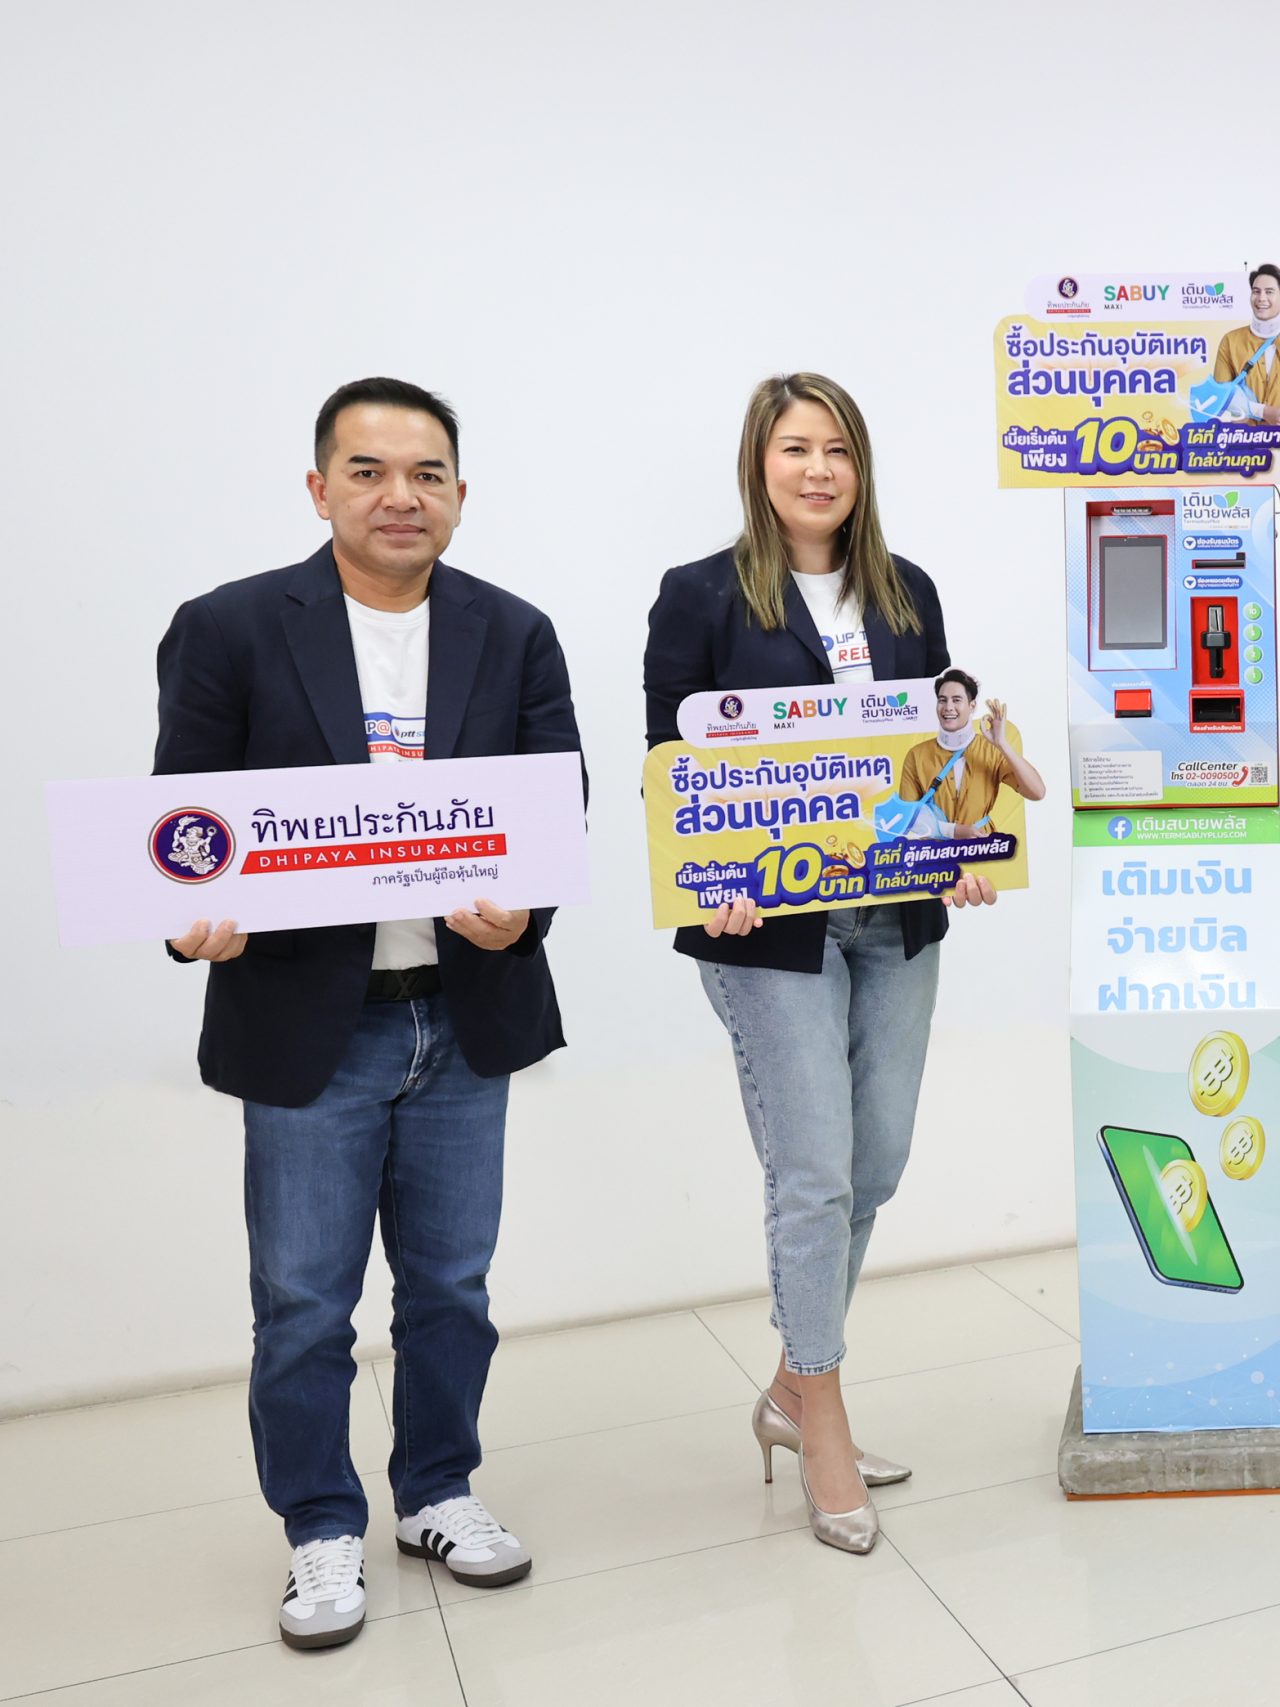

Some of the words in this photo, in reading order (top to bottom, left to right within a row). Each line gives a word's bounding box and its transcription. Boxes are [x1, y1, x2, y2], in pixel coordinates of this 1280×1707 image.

[1104, 285, 1170, 302] SABUY
[1181, 283, 1205, 295] เติม
[1182, 294, 1234, 304] สบายพลัส
[1006, 325, 1207, 364] ซื้อประกันอุบัติเหตุ
[1008, 360, 1177, 407] ส่วนบุคคล
[1004, 426, 1067, 446] เบี้ยเริ่มต้น
[1075, 420, 1138, 464] 10
[1187, 424, 1217, 445] ได้ที่
[1023, 450, 1067, 468] เพียง
[1133, 451, 1179, 470] บาท
[1188, 450, 1267, 471] ใกล้บ้านคุณ
[1183, 492, 1212, 507] เติม
[1183, 505, 1250, 519] สบายพลัส
[836, 632, 854, 644] UP
[773, 698, 848, 720] SABUY
[861, 695, 886, 708] เติม
[862, 705, 918, 719] สบายพลัส
[671, 755, 891, 792] ซื้อประกันอุบัติเหตุ
[1171, 771, 1184, 780] โทร
[1185, 772, 1240, 780] 02-0090500
[1178, 761, 1238, 771] CallCenter
[251, 798, 495, 843] ทิพยประกันภัย
[675, 792, 860, 840] ส่วนบุคคล
[1137, 815, 1247, 832] เติมสบายพลัส
[1137, 831, 1247, 840] WWW.TERMSABUYPLUS.COM
[259, 849, 357, 868] DHIPAYA
[370, 839, 496, 860] INSURANCE
[873, 843, 902, 866] ได้ที่
[903, 839, 1010, 867] ตู้เติมสบายพลัส
[372, 864, 499, 887] ภาครัฐเป็นผู้ถือหุ้นใหญ่
[678, 863, 747, 885] เบี้ยเริ่มต้น
[756, 847, 823, 897] 10
[875, 870, 955, 889] ใกล้บ้านคุณ
[1102, 860, 1252, 896] เติมเงิน
[818, 876, 865, 897] บาท
[1107, 917, 1248, 954] จ่ายบิล
[1098, 974, 1256, 1011] ฝากเงิน
